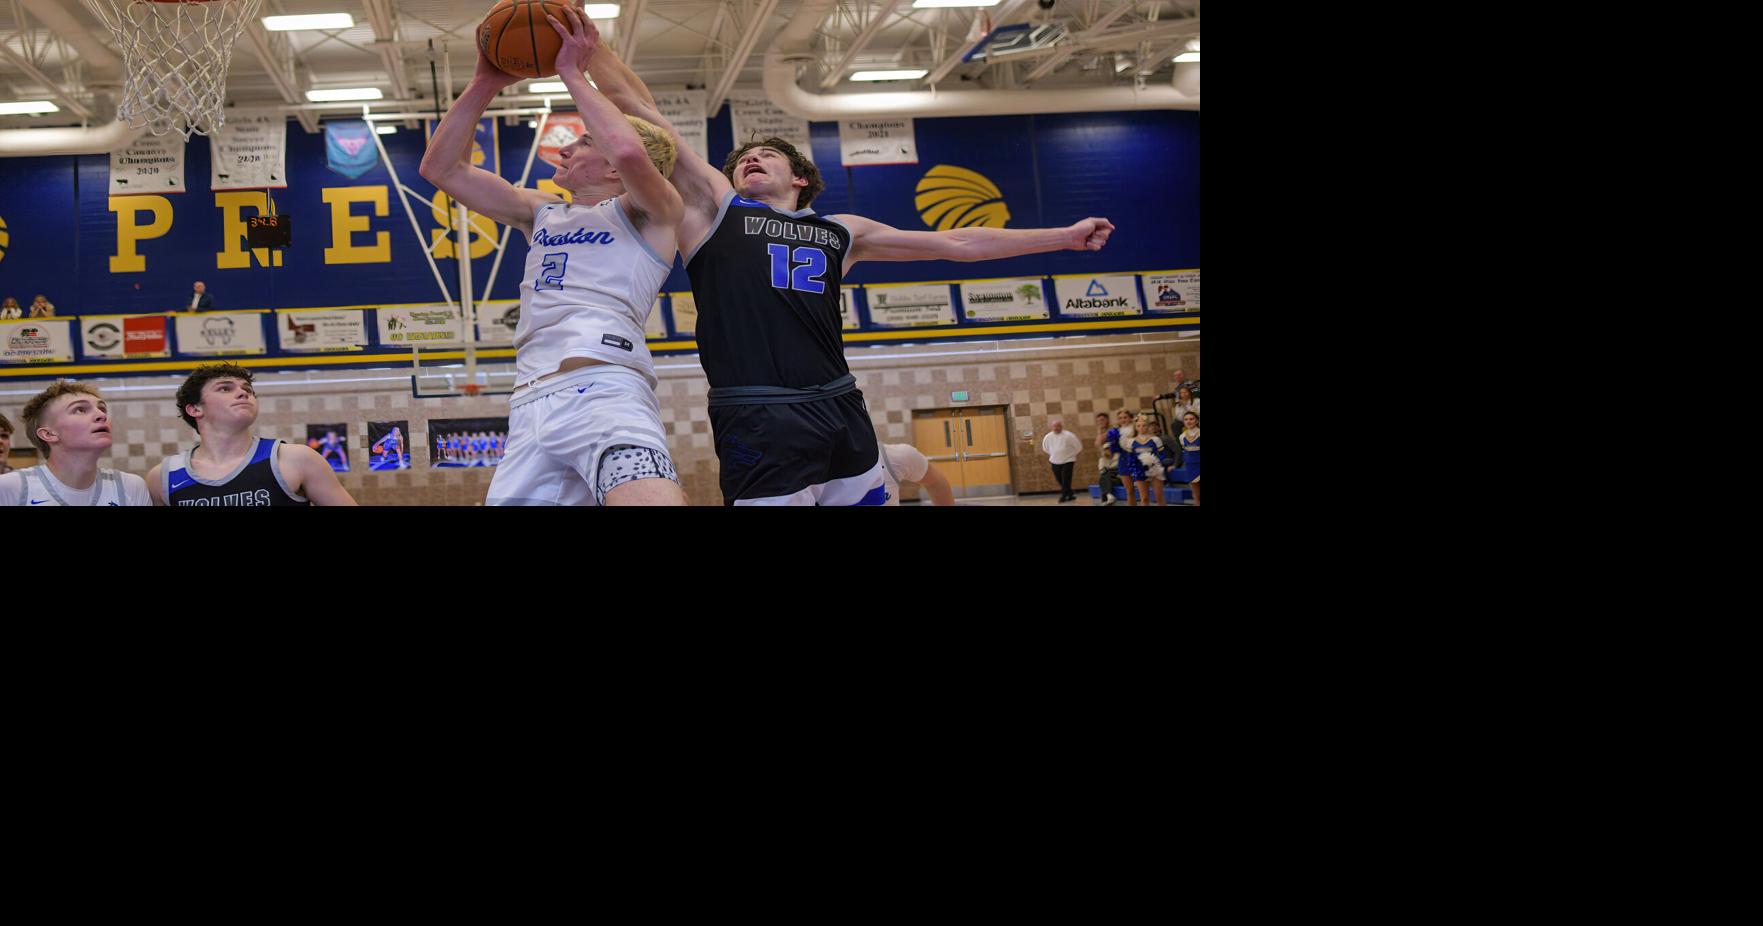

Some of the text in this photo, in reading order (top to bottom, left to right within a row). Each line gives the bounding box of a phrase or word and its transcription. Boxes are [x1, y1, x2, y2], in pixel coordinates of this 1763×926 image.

[745, 216, 841, 250] WOLVES
[534, 252, 569, 292] 2
[767, 243, 827, 294] 12
[1065, 296, 1128, 309] Altabank
